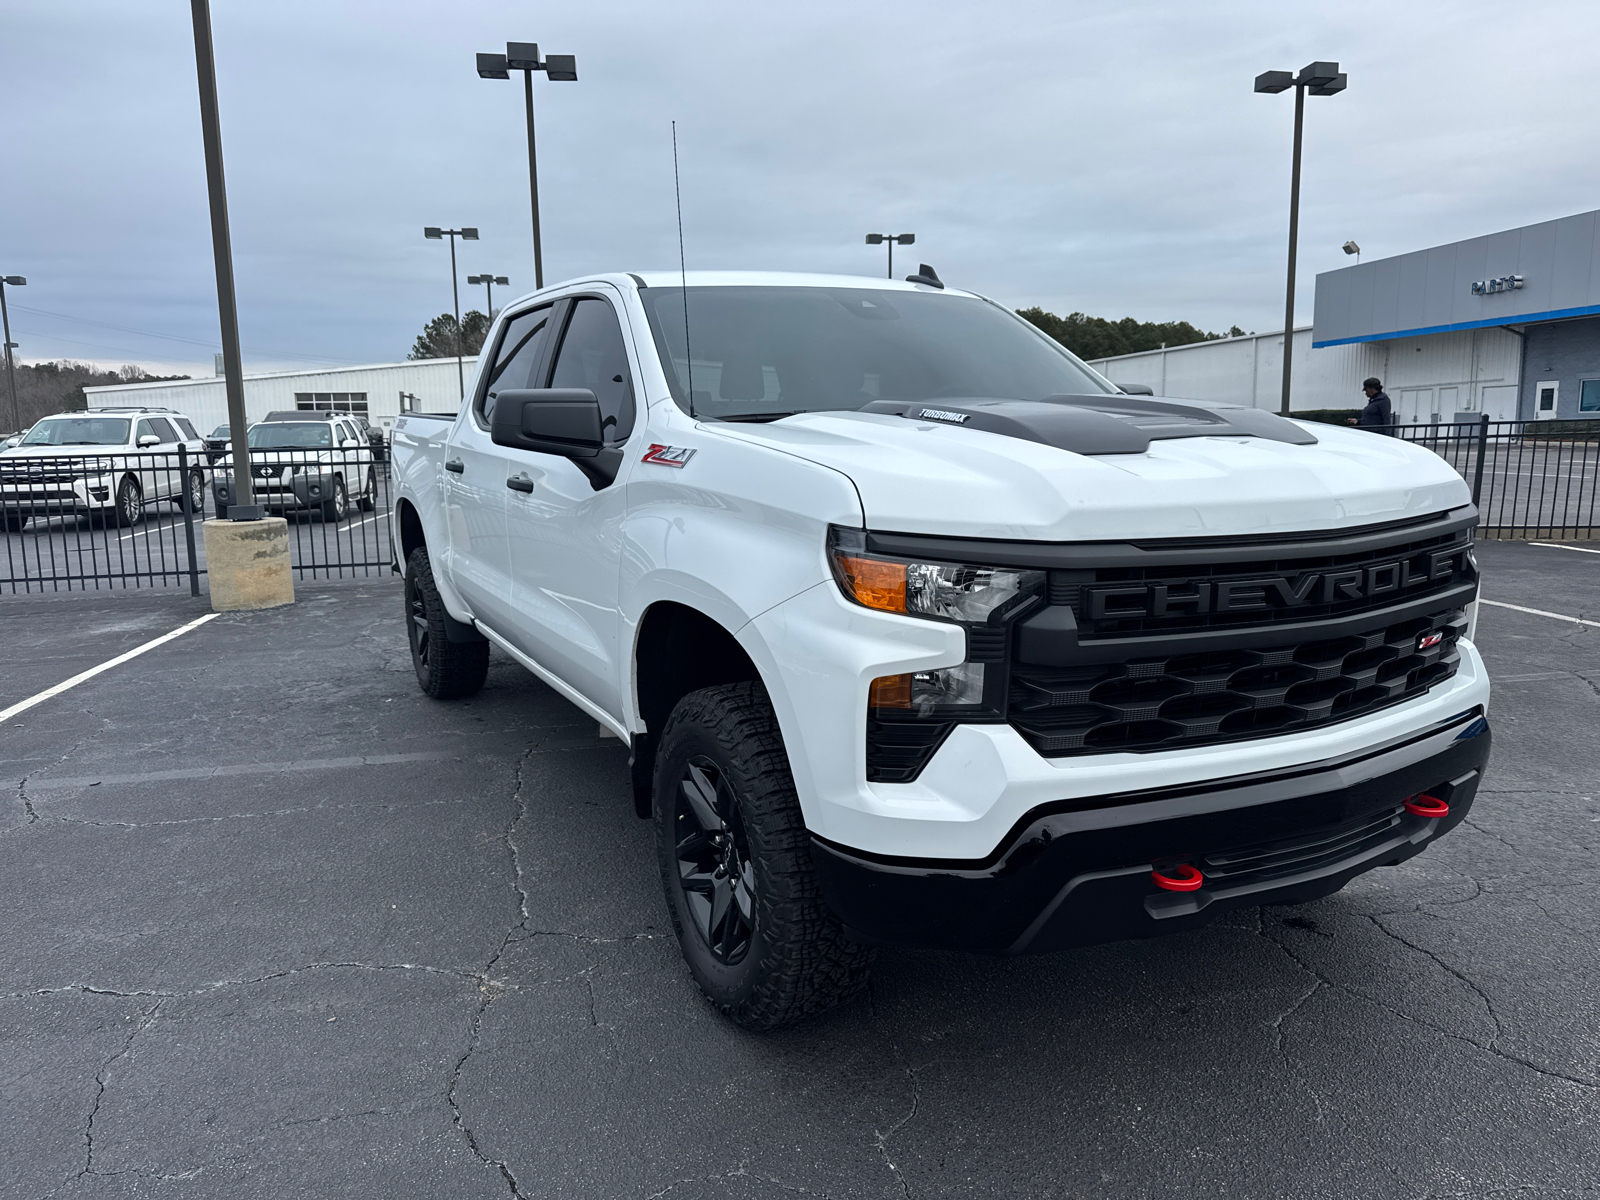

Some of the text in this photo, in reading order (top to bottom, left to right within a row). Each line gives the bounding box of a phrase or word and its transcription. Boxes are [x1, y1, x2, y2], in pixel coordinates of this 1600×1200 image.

[1472, 275, 1518, 295] PARTS
[919, 408, 970, 423] TURBOMAX
[641, 443, 697, 469] Z71
[1083, 542, 1474, 620] CHEVROLET
